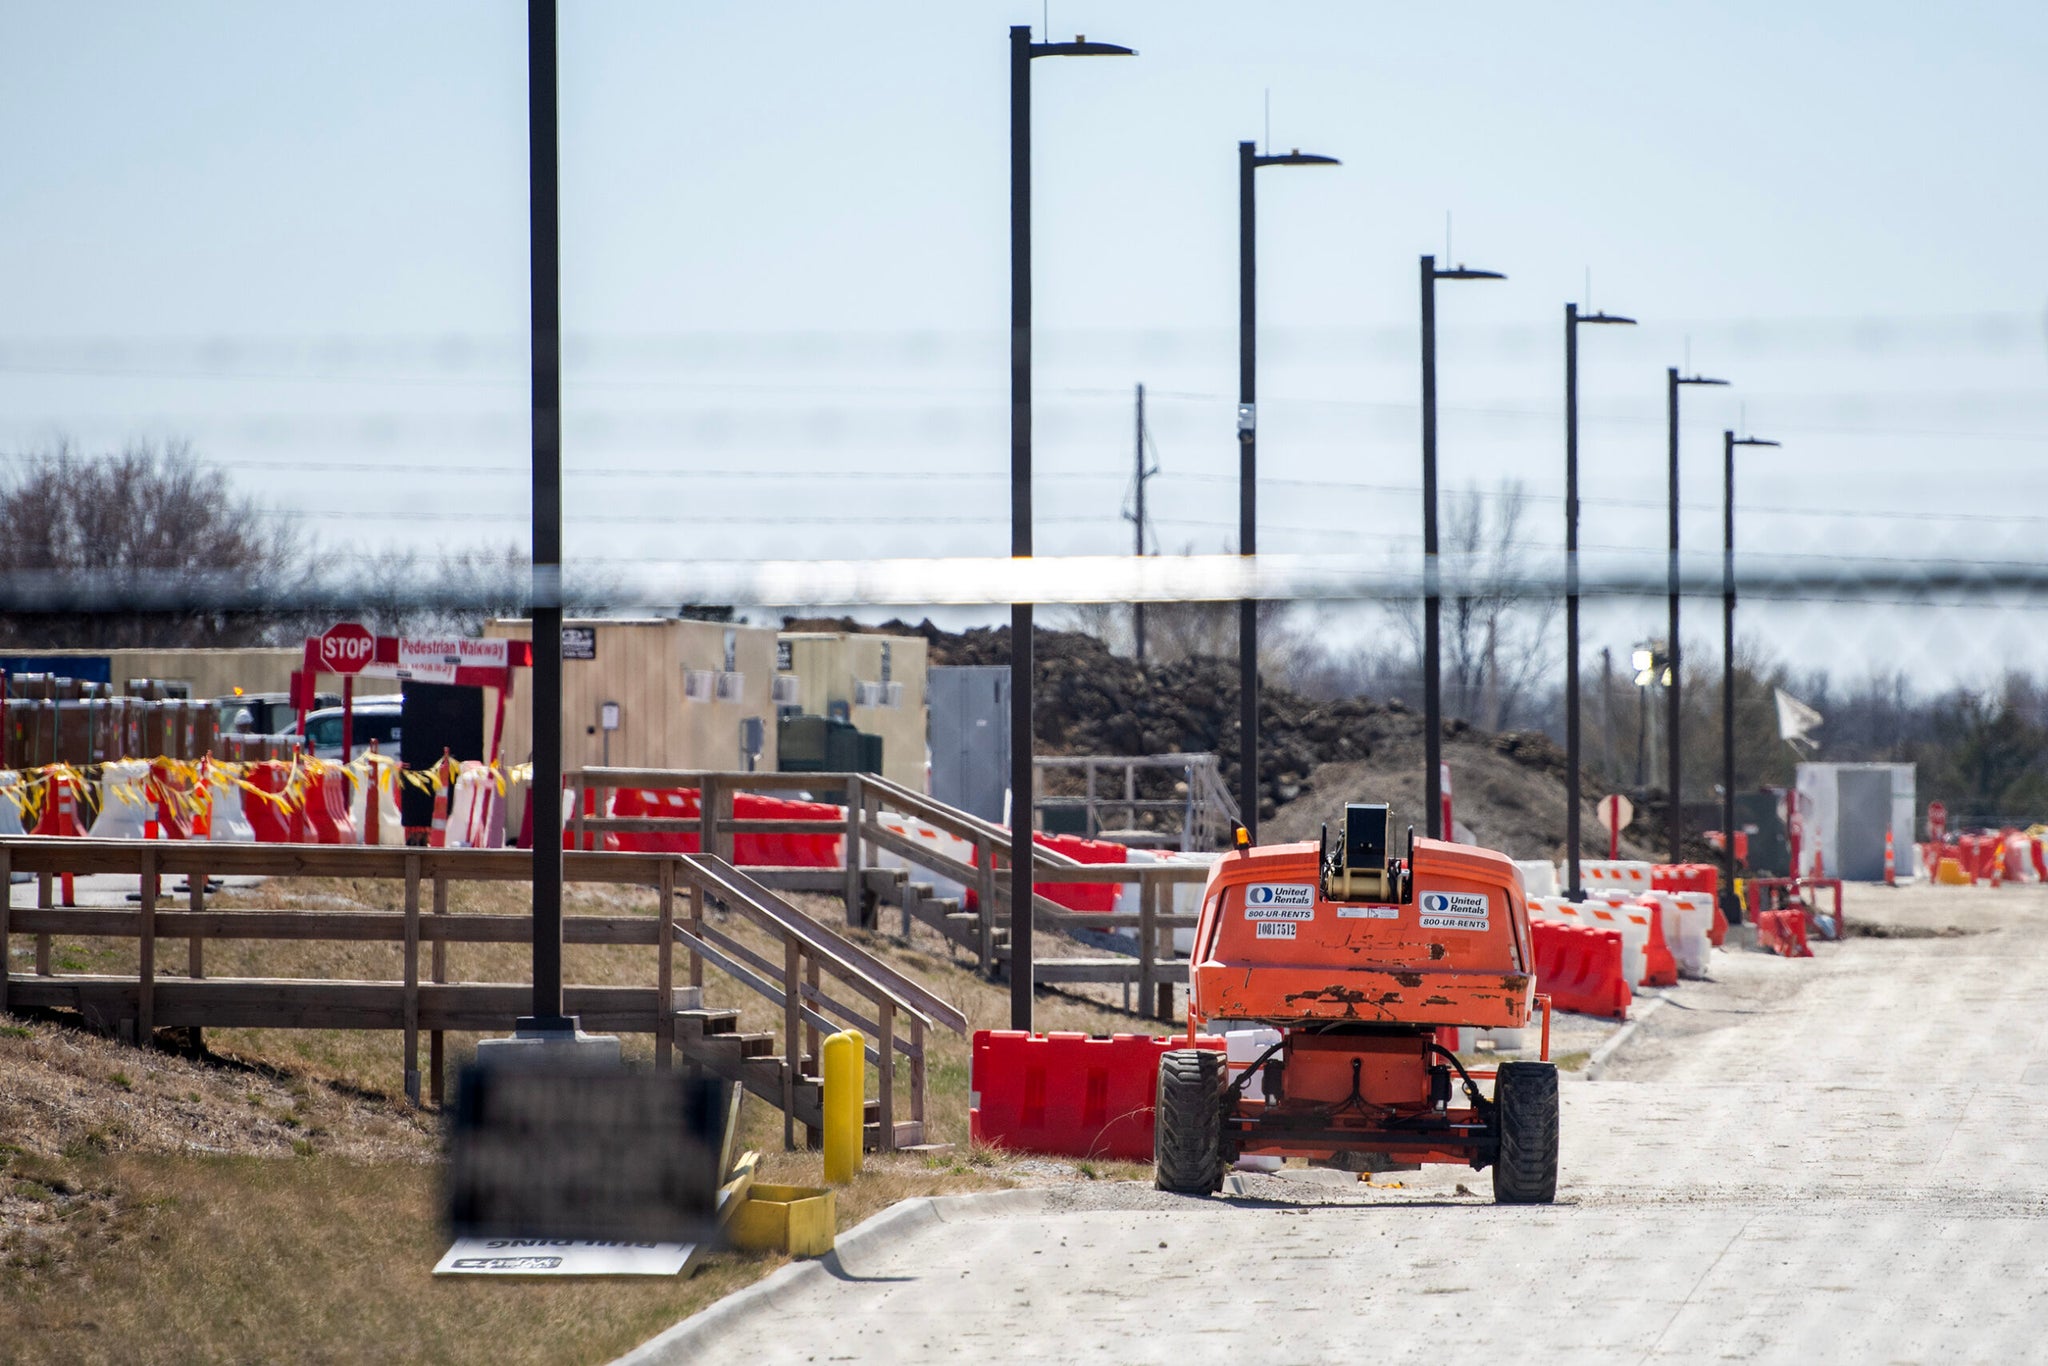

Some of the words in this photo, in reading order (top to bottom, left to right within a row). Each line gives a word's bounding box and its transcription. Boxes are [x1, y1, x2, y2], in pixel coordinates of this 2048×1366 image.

[324, 636, 372, 660] STOP
[401, 638, 456, 656] Pedestrian
[458, 639, 504, 661] Walkway
[1275, 887, 1308, 896] United
[1274, 896, 1310, 904] Rentals
[1450, 896, 1482, 906] United
[1248, 910, 1311, 918] 800-UR-RENTS
[1450, 905, 1485, 914] Rentals
[1423, 918, 1486, 928] 800-UR-RENTS
[1258, 923, 1296, 936] 10817512
